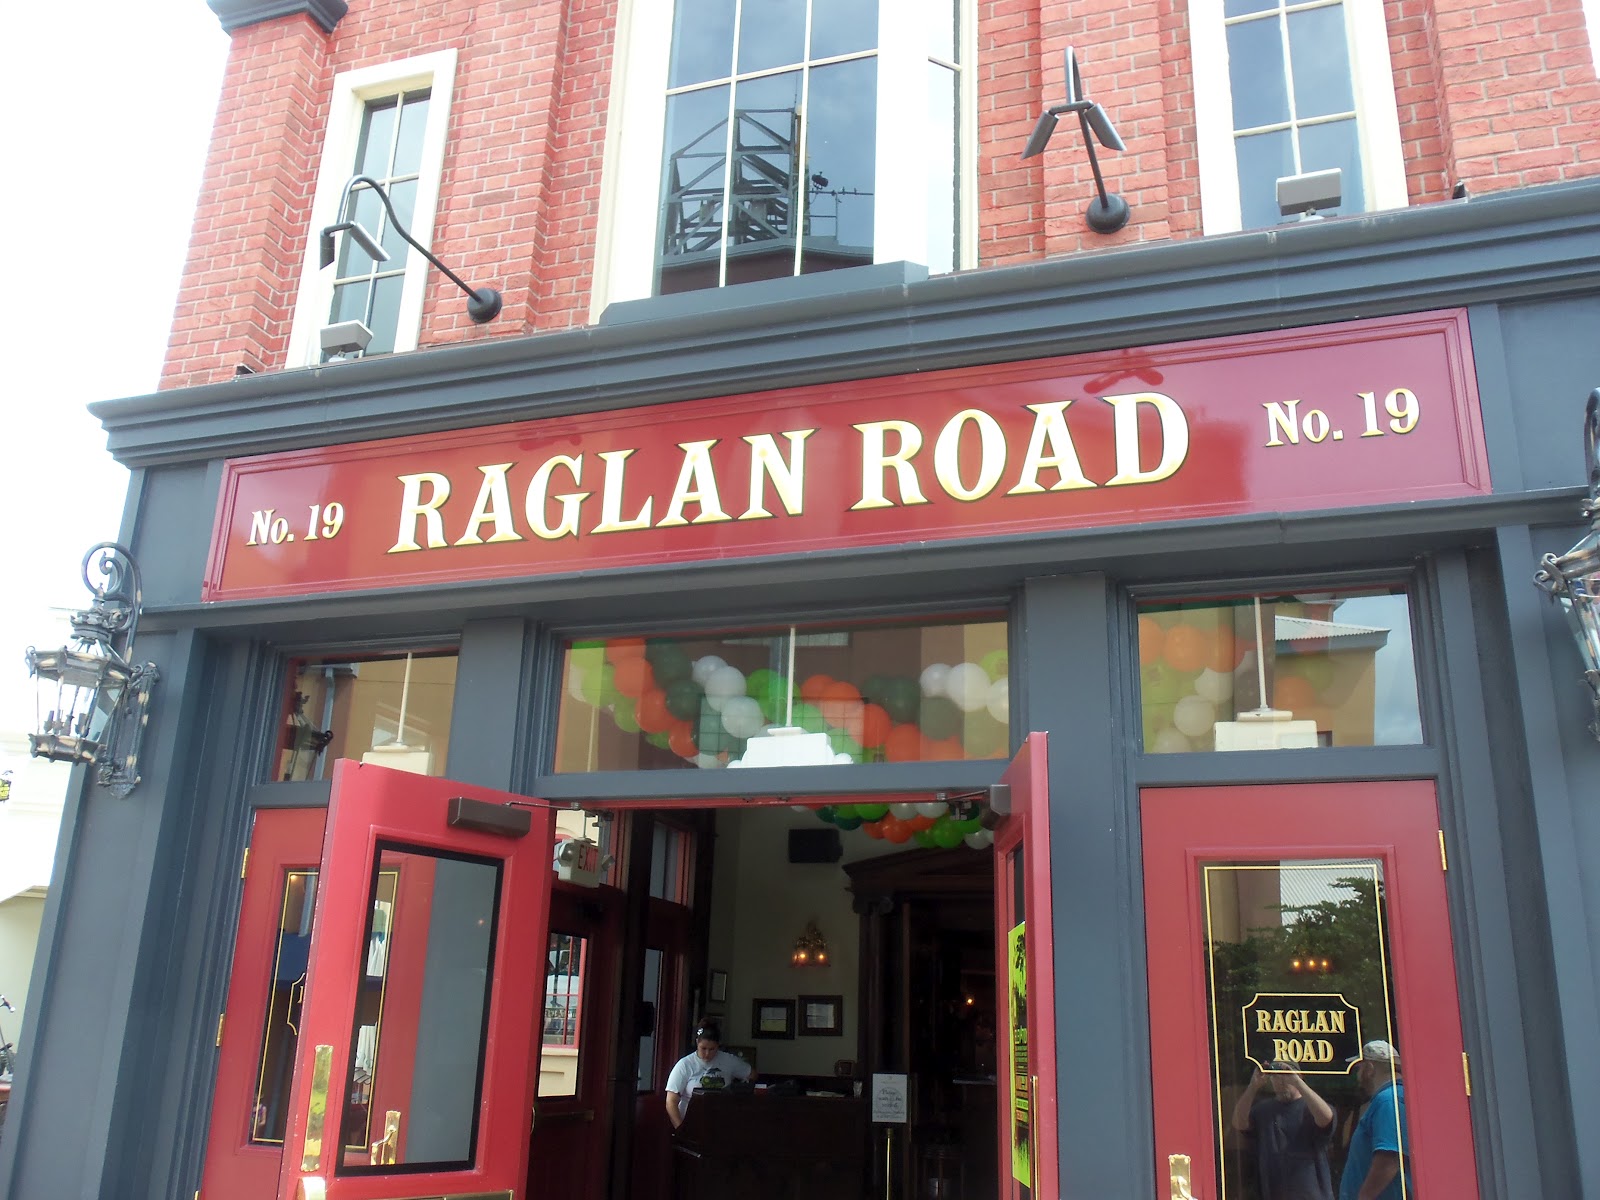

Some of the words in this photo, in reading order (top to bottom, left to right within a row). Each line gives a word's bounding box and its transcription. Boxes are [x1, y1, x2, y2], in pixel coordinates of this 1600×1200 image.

[1263, 399, 1344, 447] No.
[1359, 387, 1421, 437] 19
[388, 428, 819, 554] RAGLAN
[849, 391, 1190, 512] ROAD
[245, 509, 294, 546] No.
[303, 502, 344, 541] 19
[578, 844, 599, 873] EXIT
[1256, 1009, 1346, 1034] RAGLAN
[1273, 1038, 1334, 1063] ROAD
